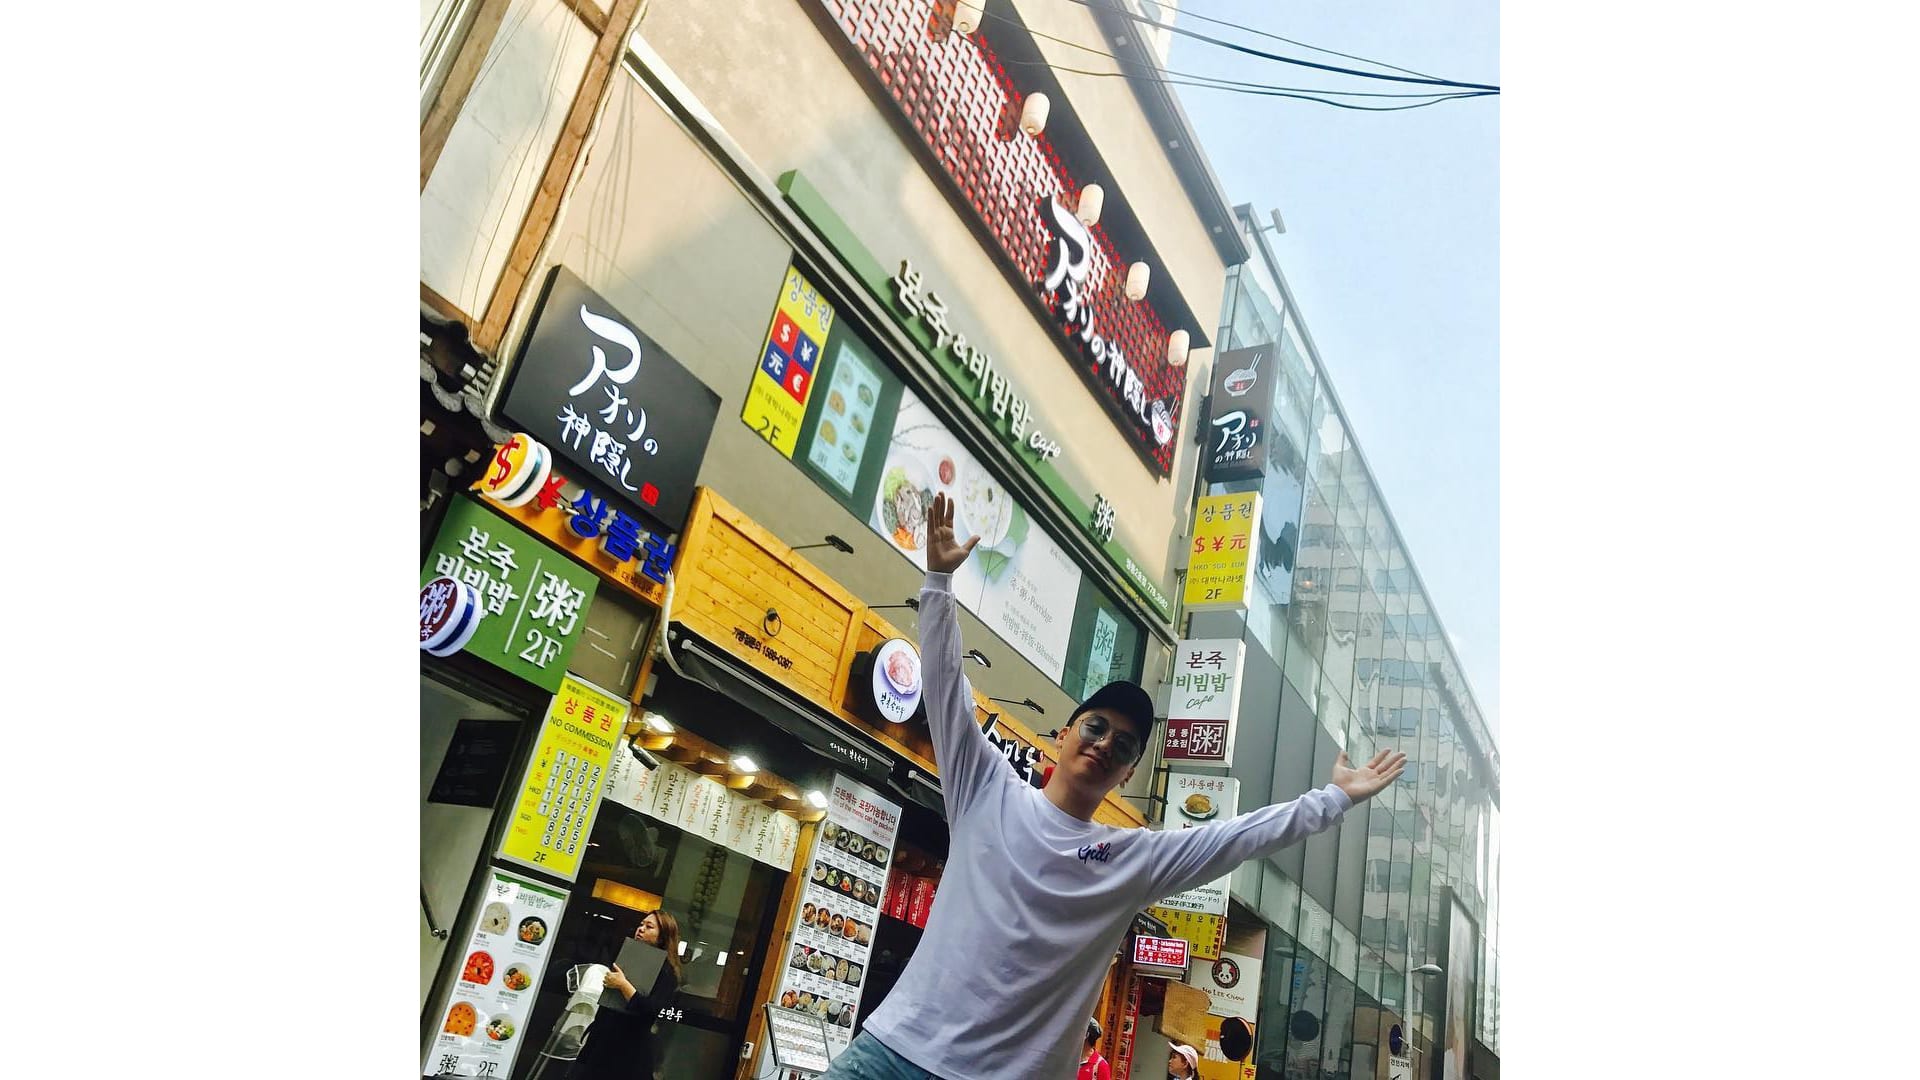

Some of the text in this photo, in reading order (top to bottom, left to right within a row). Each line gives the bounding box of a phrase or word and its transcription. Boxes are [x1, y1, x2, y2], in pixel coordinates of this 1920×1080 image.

[789, 273, 834, 333] 상품권
[768, 352, 784, 376] 元
[757, 415, 782, 443] 2F
[1201, 501, 1253, 523] 상품권
[570, 488, 679, 584] 상품권
[457, 526, 519, 580] 본죽
[435, 552, 520, 617] 비빔밥
[1205, 588, 1223, 600] 2F
[518, 628, 564, 670] 2F
[1186, 650, 1227, 670] 본죽
[1175, 672, 1233, 694] 비빔밥
[565, 696, 615, 733] 상품권
[549, 714, 563, 729] NO
[564, 721, 614, 752] COMMISSION
[1166, 739, 1188, 749] 2호점
[532, 850, 547, 864] 2F
